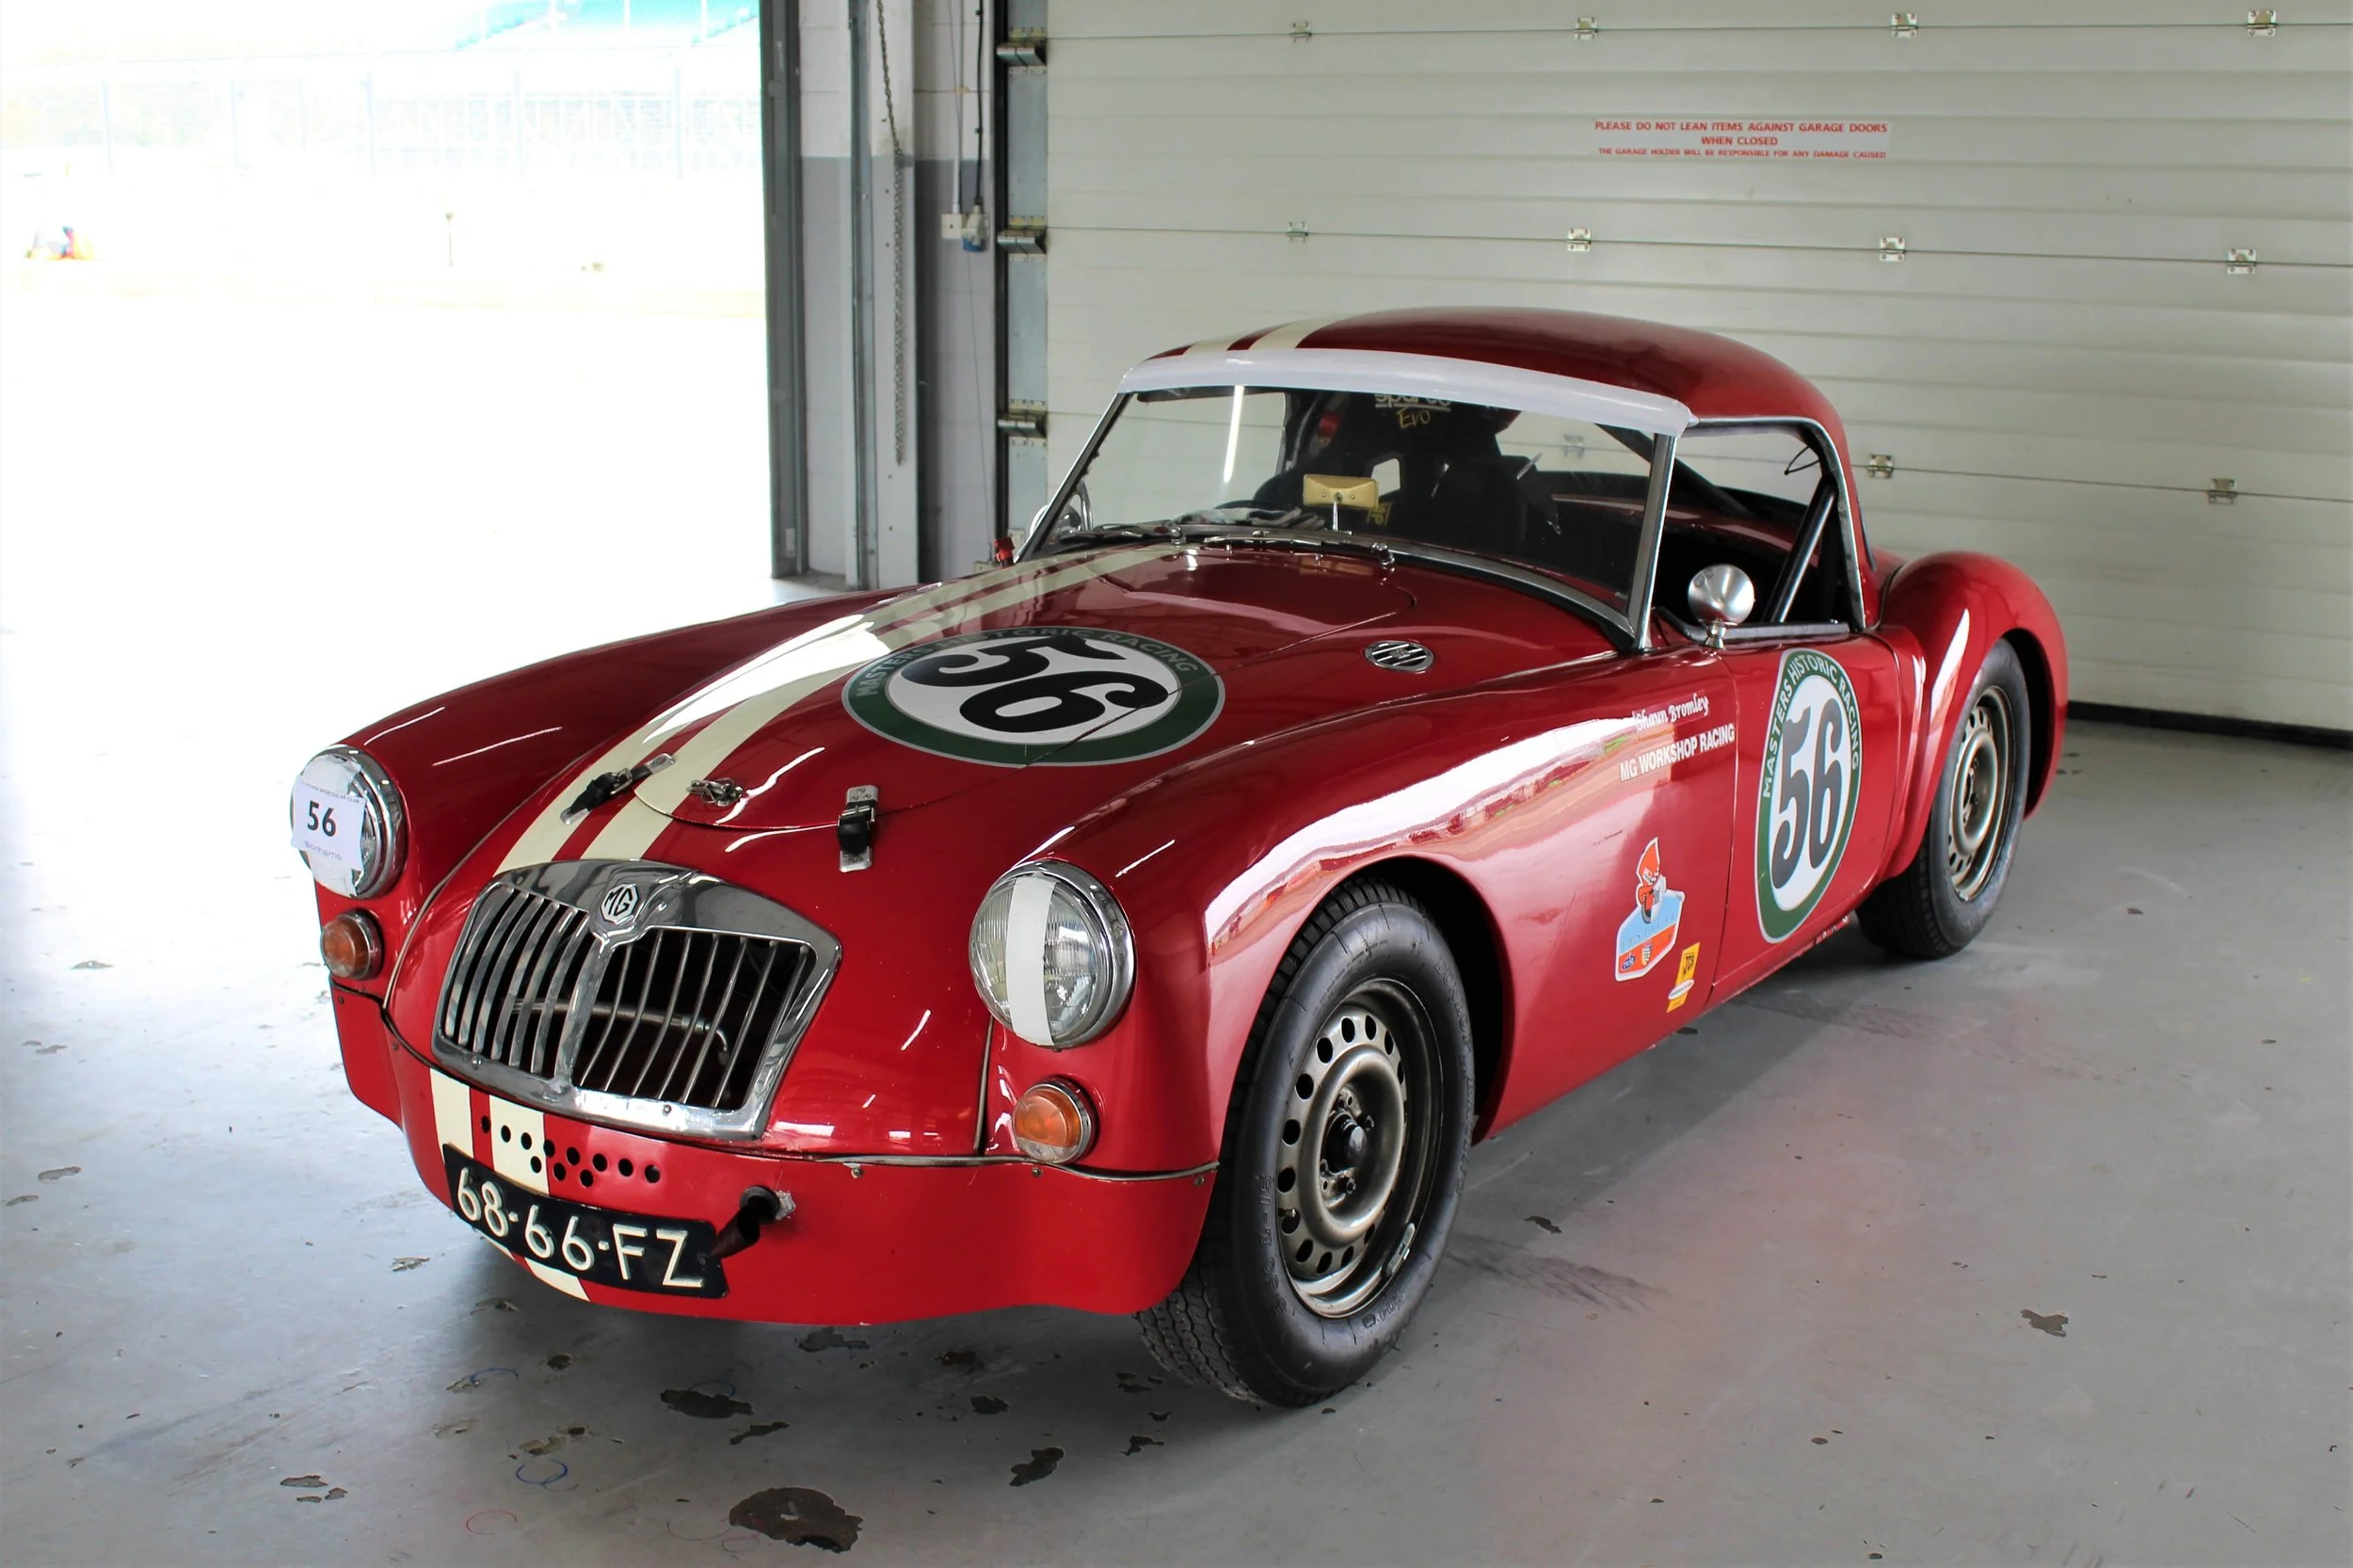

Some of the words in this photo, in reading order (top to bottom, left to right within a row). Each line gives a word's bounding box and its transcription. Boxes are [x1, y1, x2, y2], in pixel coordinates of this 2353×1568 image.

[1594, 120, 1632, 131] PLEASE
[1636, 121, 1652, 131] DO
[1656, 121, 1676, 131] NOT
[1680, 121, 1707, 131] LEAN
[1711, 121, 1743, 132] ITEMS
[1748, 122, 1795, 132] AGAINST
[1799, 122, 1845, 133] GARAGE
[1849, 123, 1888, 133] DOORS
[1701, 136, 1733, 145] WHEN
[1737, 136, 1778, 146] CLOSED
[1651, 148, 1681, 156] HOLDER
[1853, 151, 1887, 159] CAUSED
[856, 647, 934, 697] MASTERS
[1100, 632, 1199, 672] RACING
[901, 634, 1169, 733] 56
[1635, 709, 1669, 731] Shaun
[1668, 693, 1709, 723] Bromley
[1763, 680, 1792, 798] MASTERS
[1787, 654, 1838, 685] HISTORIC
[1838, 680, 1859, 770] RACING
[1619, 759, 1638, 782] MG
[1639, 736, 1698, 774] WORKSHOP
[1699, 723, 1736, 753] RACING
[1771, 697, 1844, 888] 56
[307, 799, 337, 838] 56
[603, 887, 633, 917] MG
